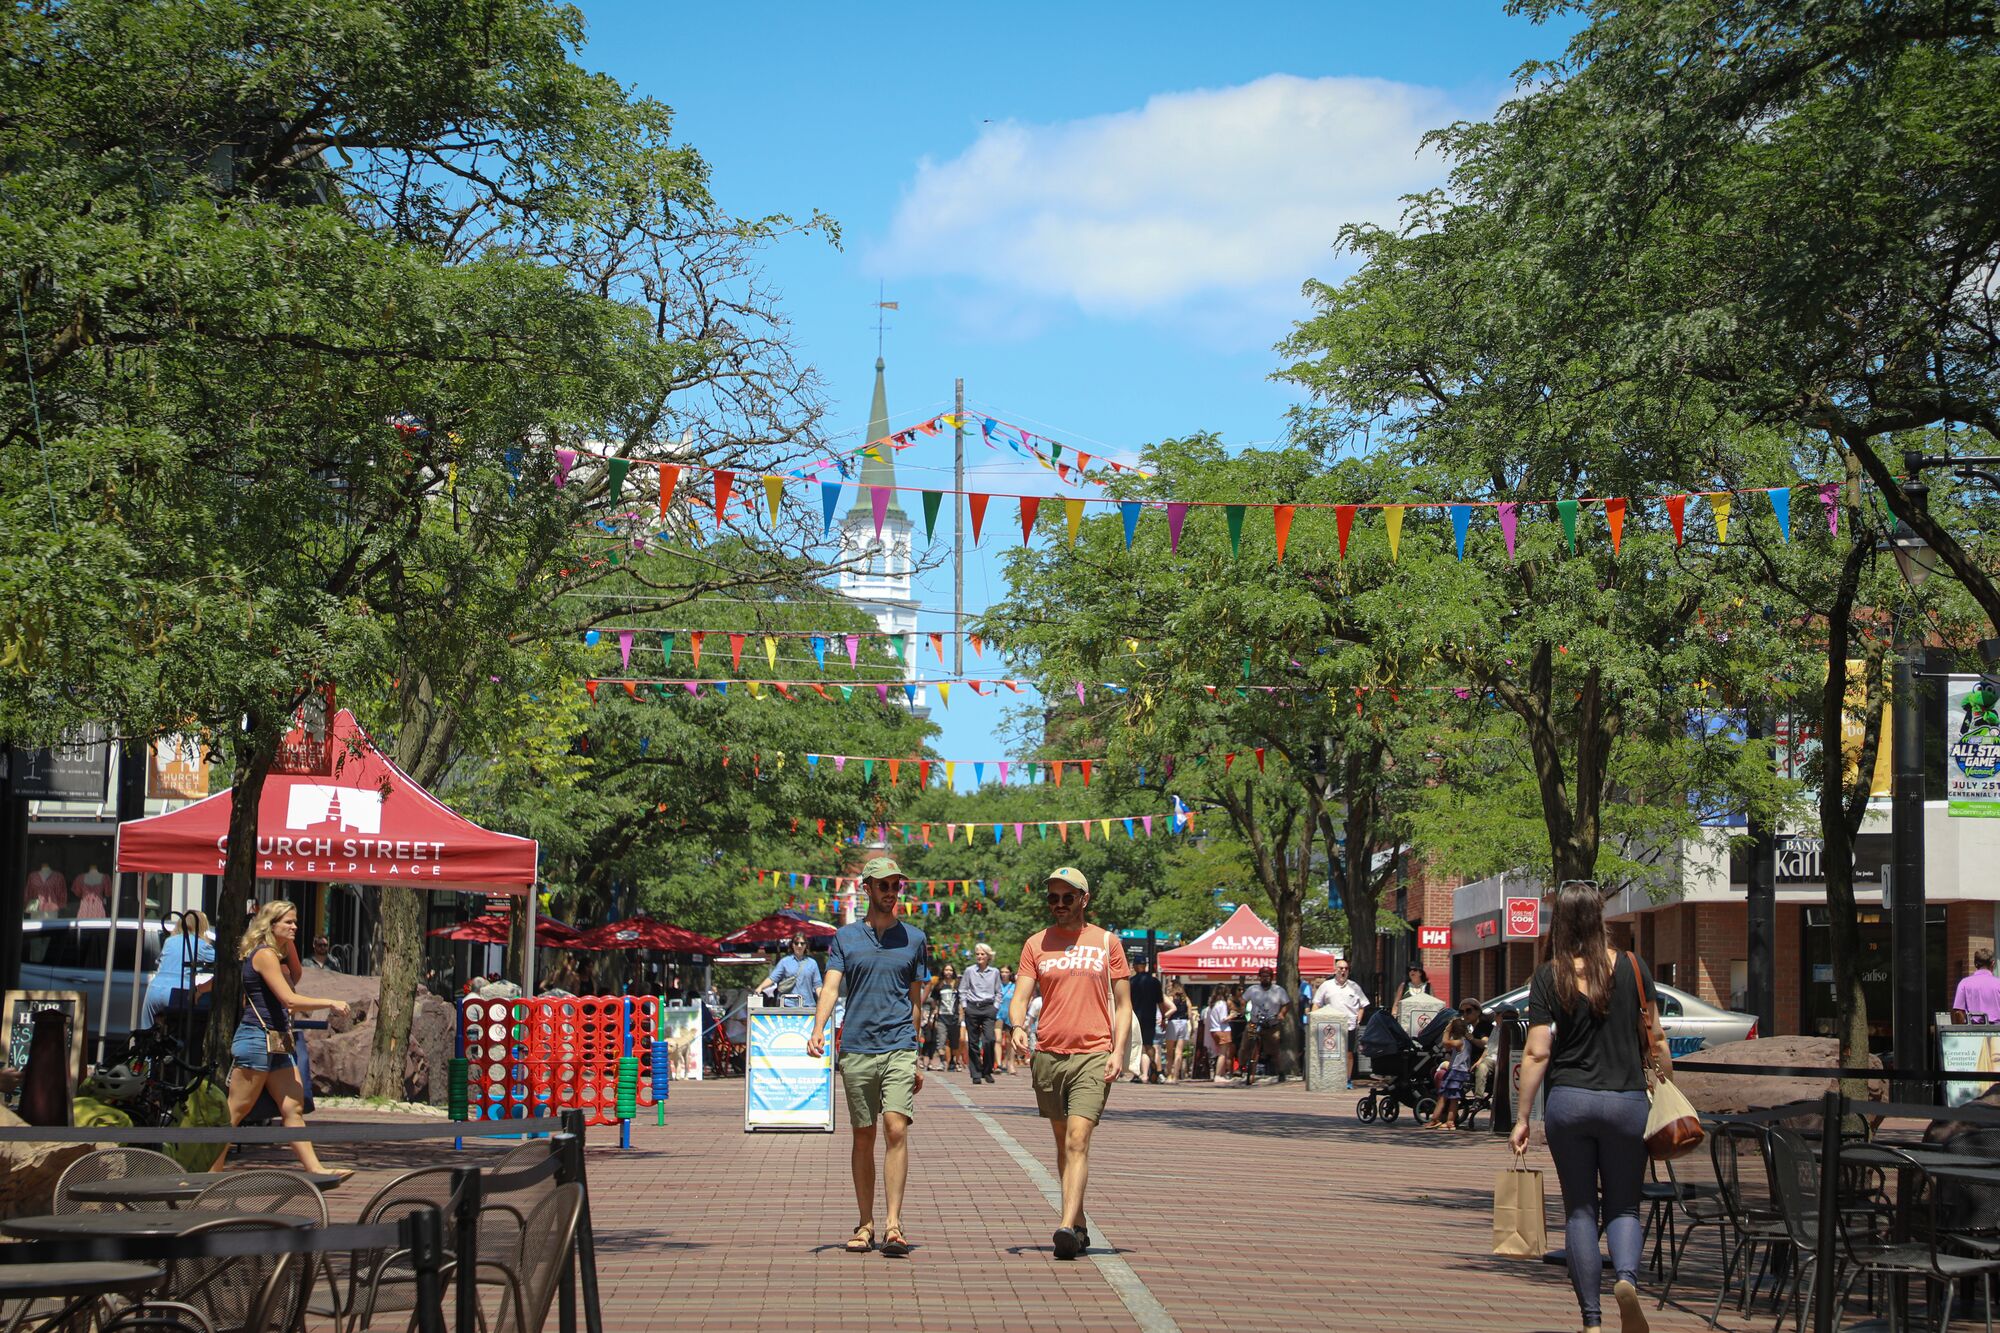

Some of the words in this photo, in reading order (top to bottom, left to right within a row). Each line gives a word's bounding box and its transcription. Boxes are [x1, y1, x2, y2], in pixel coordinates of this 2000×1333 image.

[1965, 757, 1997, 767] GAME
[1965, 766, 1996, 777] Vermont
[1953, 781, 1978, 790] JULY
[217, 835, 331, 857] CURCH
[343, 839, 446, 861] STREET
[1786, 840, 1821, 850] BANK
[218, 859, 441, 875] MRKETPLACE
[1212, 935, 1277, 947] ALIVE
[1065, 945, 1106, 960] CITY
[1038, 957, 1104, 974] SPORTS
[1197, 957, 1238, 968] HELLY
[1241, 957, 1278, 969] HANS
